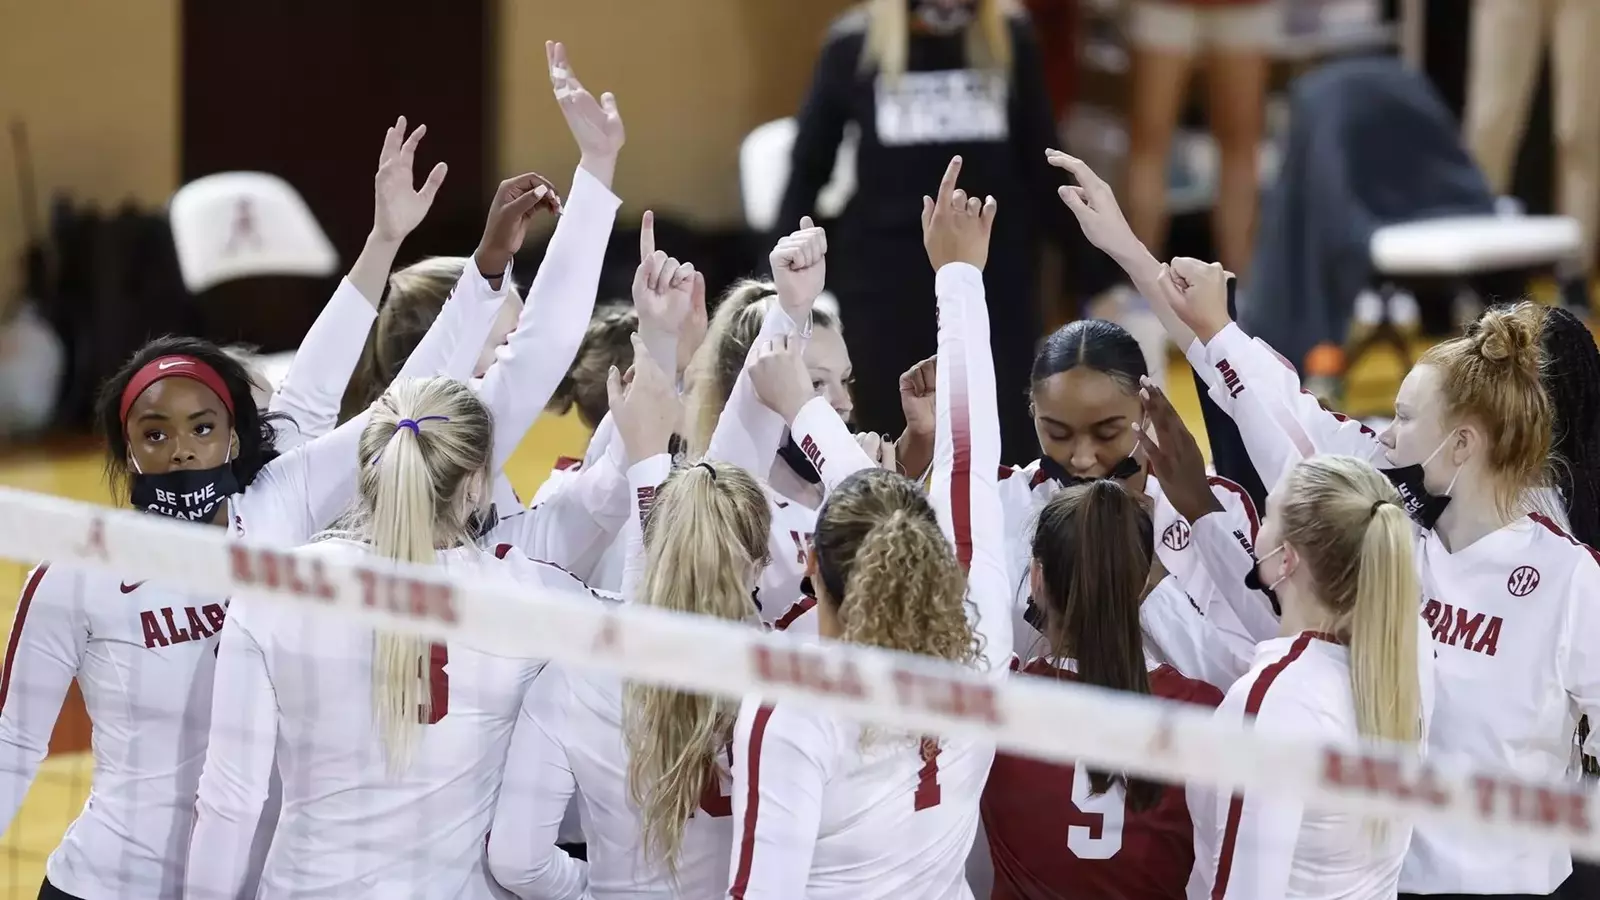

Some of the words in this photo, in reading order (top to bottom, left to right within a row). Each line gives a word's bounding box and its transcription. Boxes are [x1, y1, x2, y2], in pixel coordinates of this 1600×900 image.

[1215, 358, 1245, 399] ROLL
[801, 434, 826, 475] ROLL
[155, 488, 177, 505] BE
[181, 482, 216, 507] THE
[1162, 519, 1190, 551] SEC
[1507, 565, 1541, 597] SEC
[140, 601, 229, 648] ALAB
